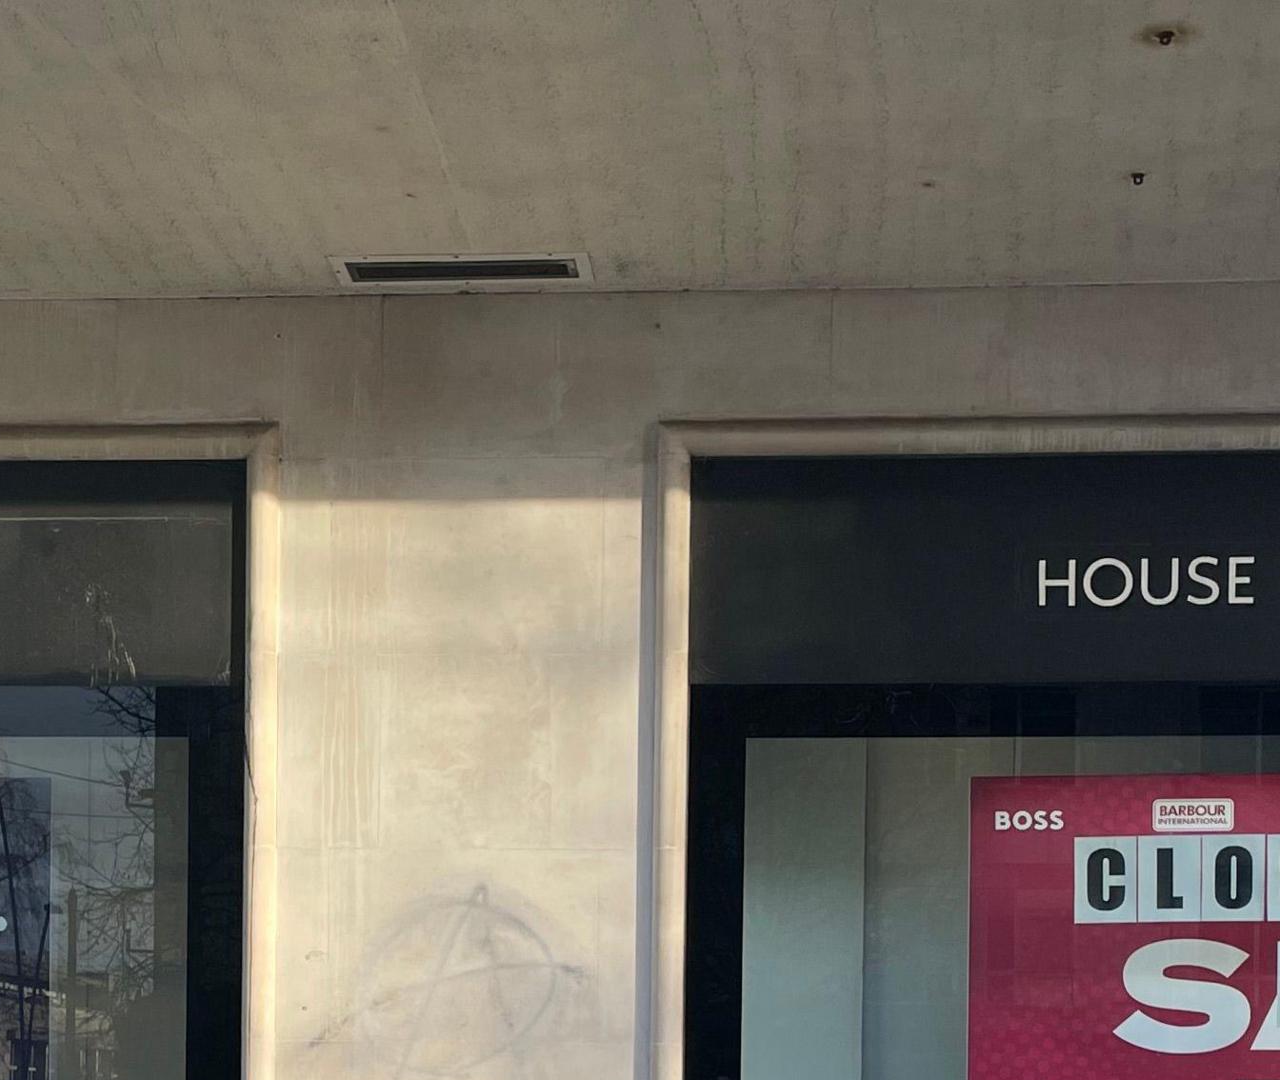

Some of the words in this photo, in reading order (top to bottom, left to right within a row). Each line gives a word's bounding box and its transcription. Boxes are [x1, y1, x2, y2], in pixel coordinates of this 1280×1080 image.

[1038, 555, 1255, 607] HOUSE
[1160, 805, 1226, 816] BARBOUR
[995, 810, 1064, 831] BOSS
[1158, 817, 1228, 825] INTERNATIONAL
